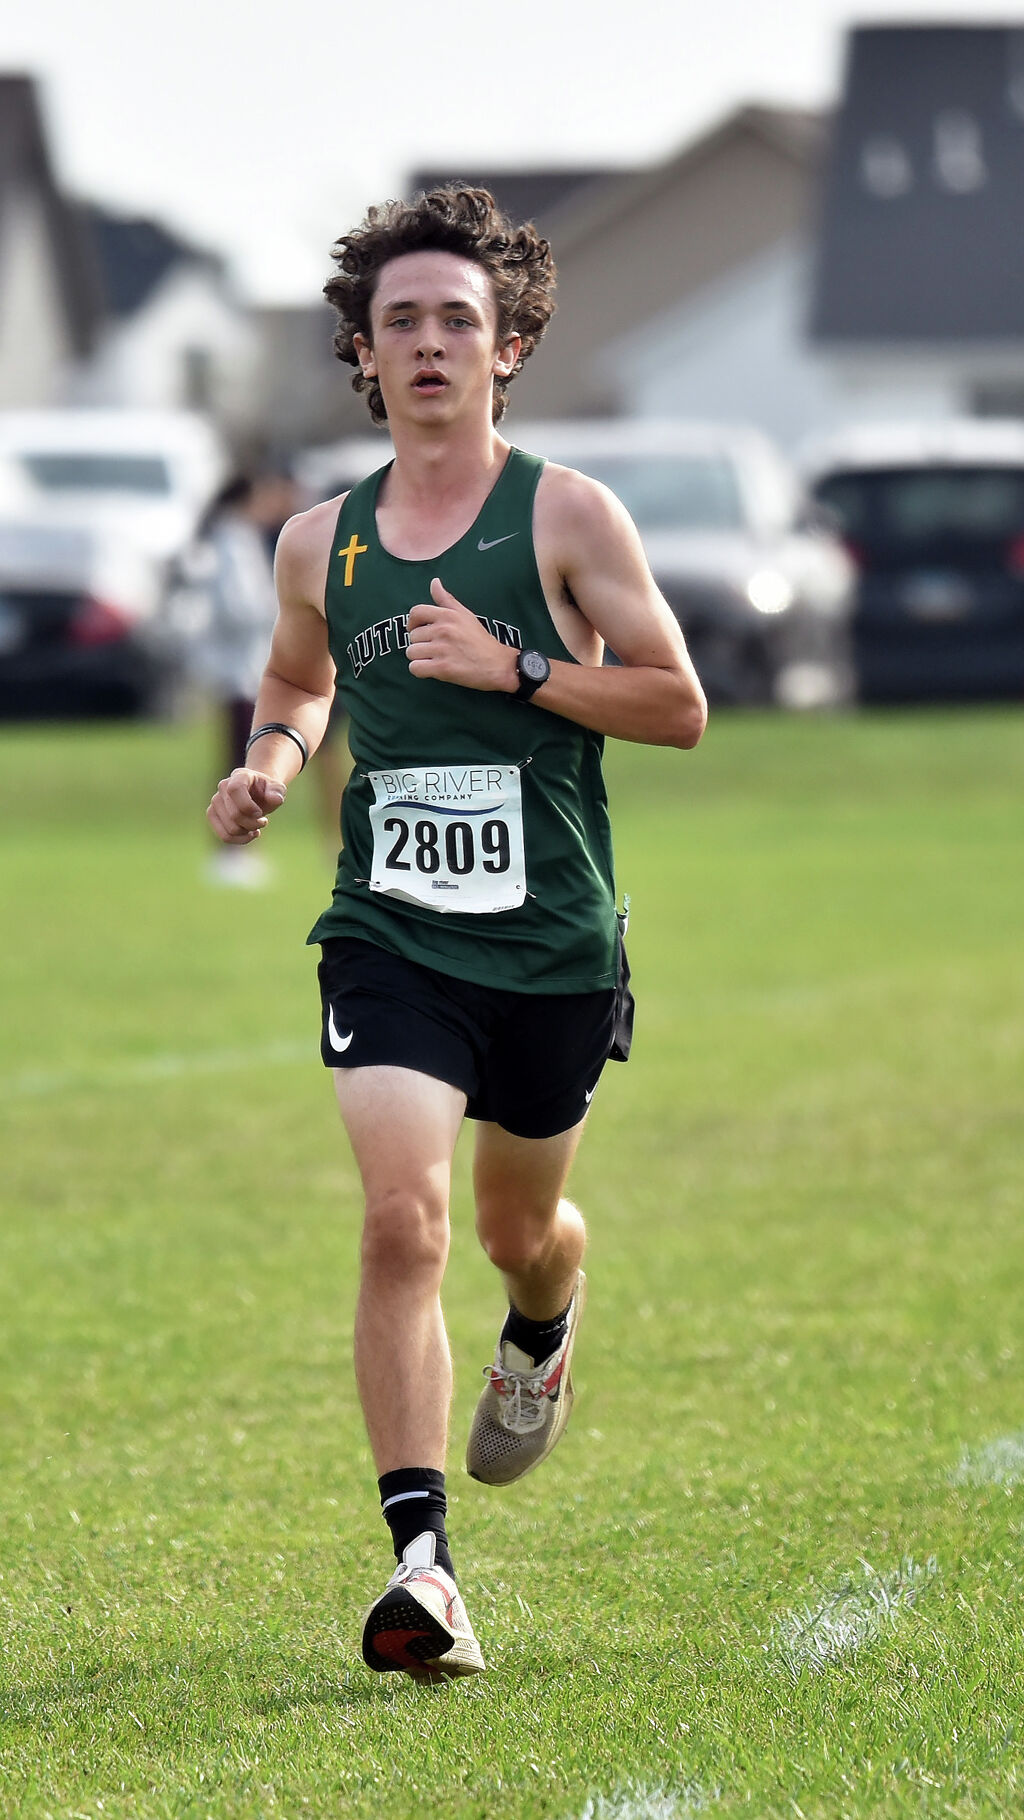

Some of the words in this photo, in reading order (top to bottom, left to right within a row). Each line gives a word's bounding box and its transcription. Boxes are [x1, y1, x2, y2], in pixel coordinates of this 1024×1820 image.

[346, 613, 523, 679] LUTHN
[381, 774, 418, 794] BIG
[425, 769, 502, 794] RIVER
[424, 793, 473, 801] COMPANY
[383, 818, 511, 875] 2809
